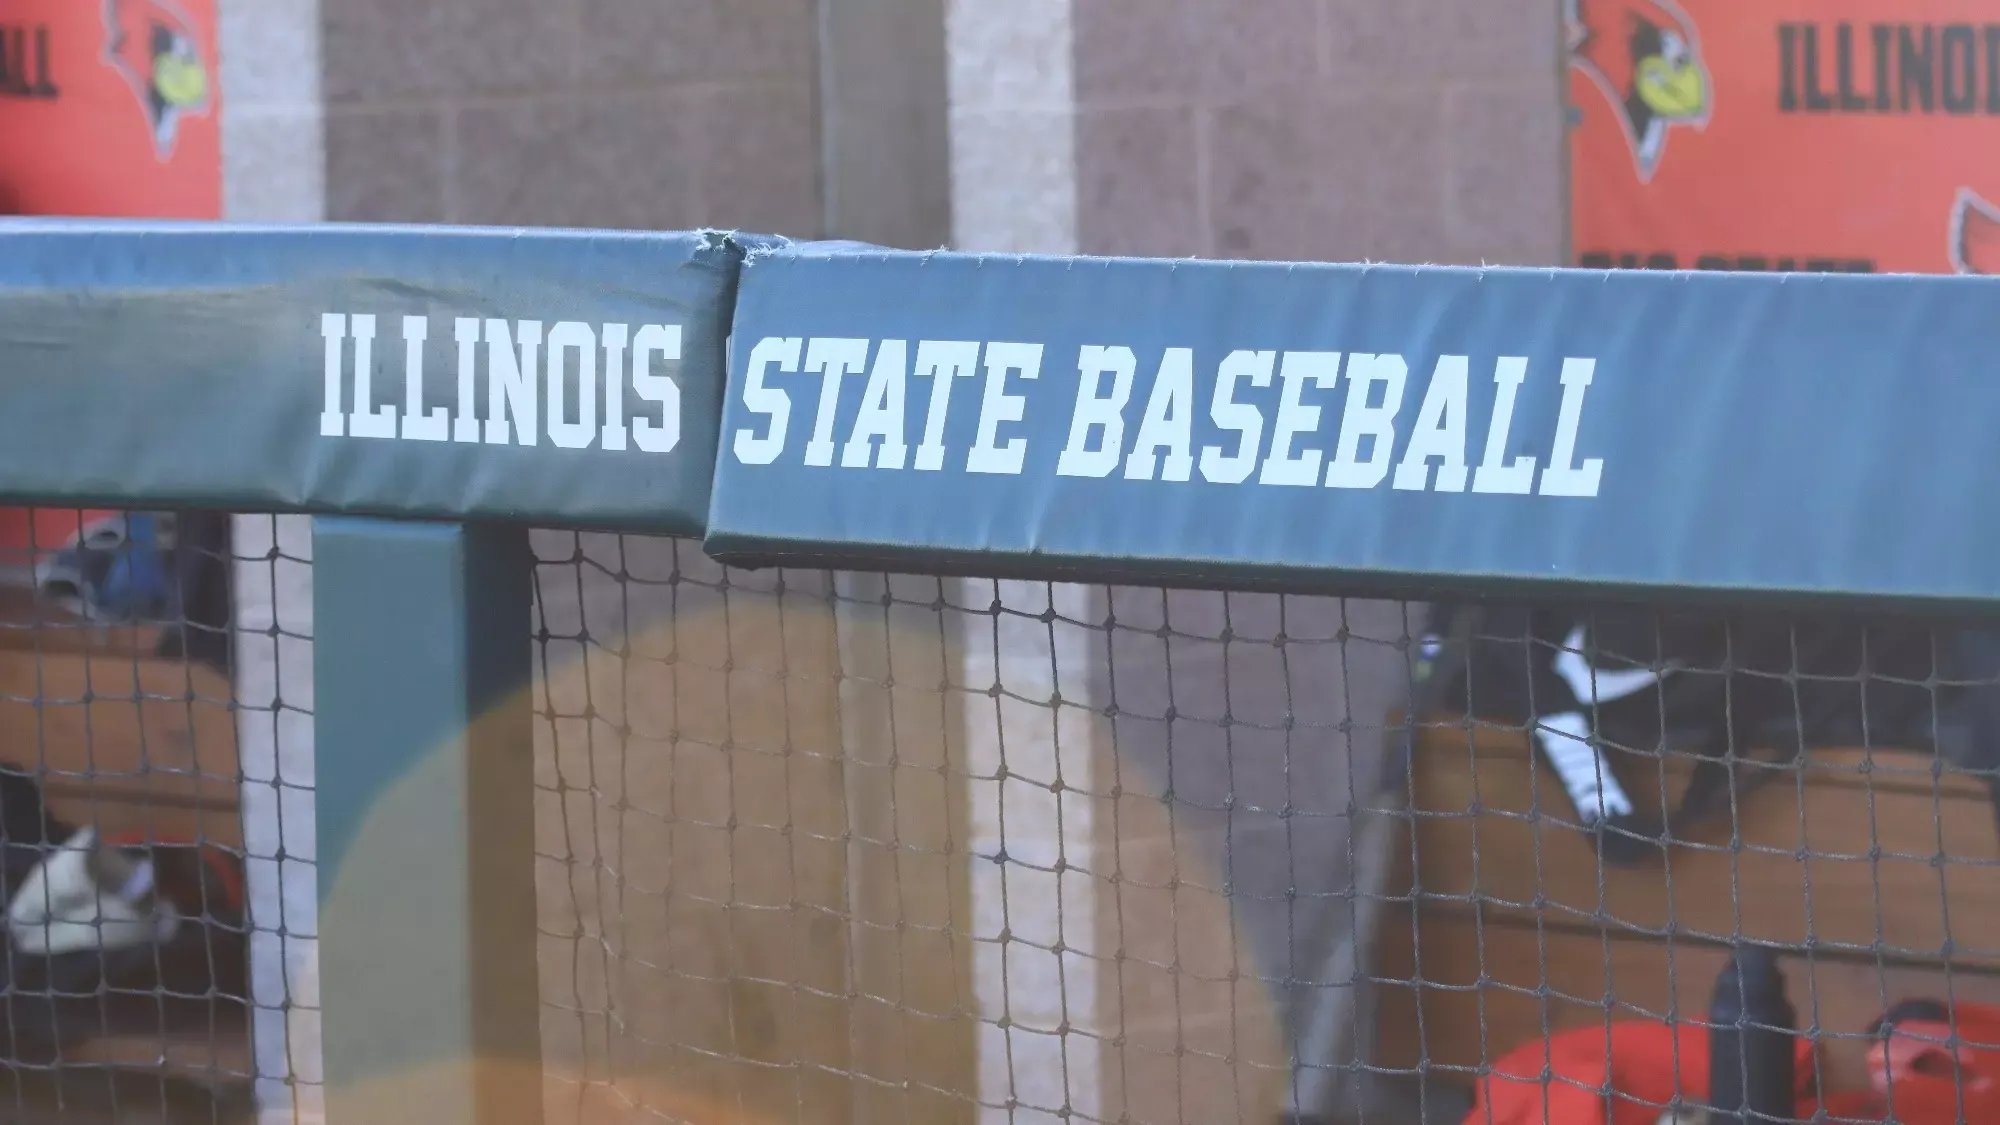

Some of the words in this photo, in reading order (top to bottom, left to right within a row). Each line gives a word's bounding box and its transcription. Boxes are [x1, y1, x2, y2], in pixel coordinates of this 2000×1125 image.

[320, 313, 682, 453] ILLINOIS
[733, 337, 1044, 475] STATE
[1056, 344, 1604, 497] BASEBALL
